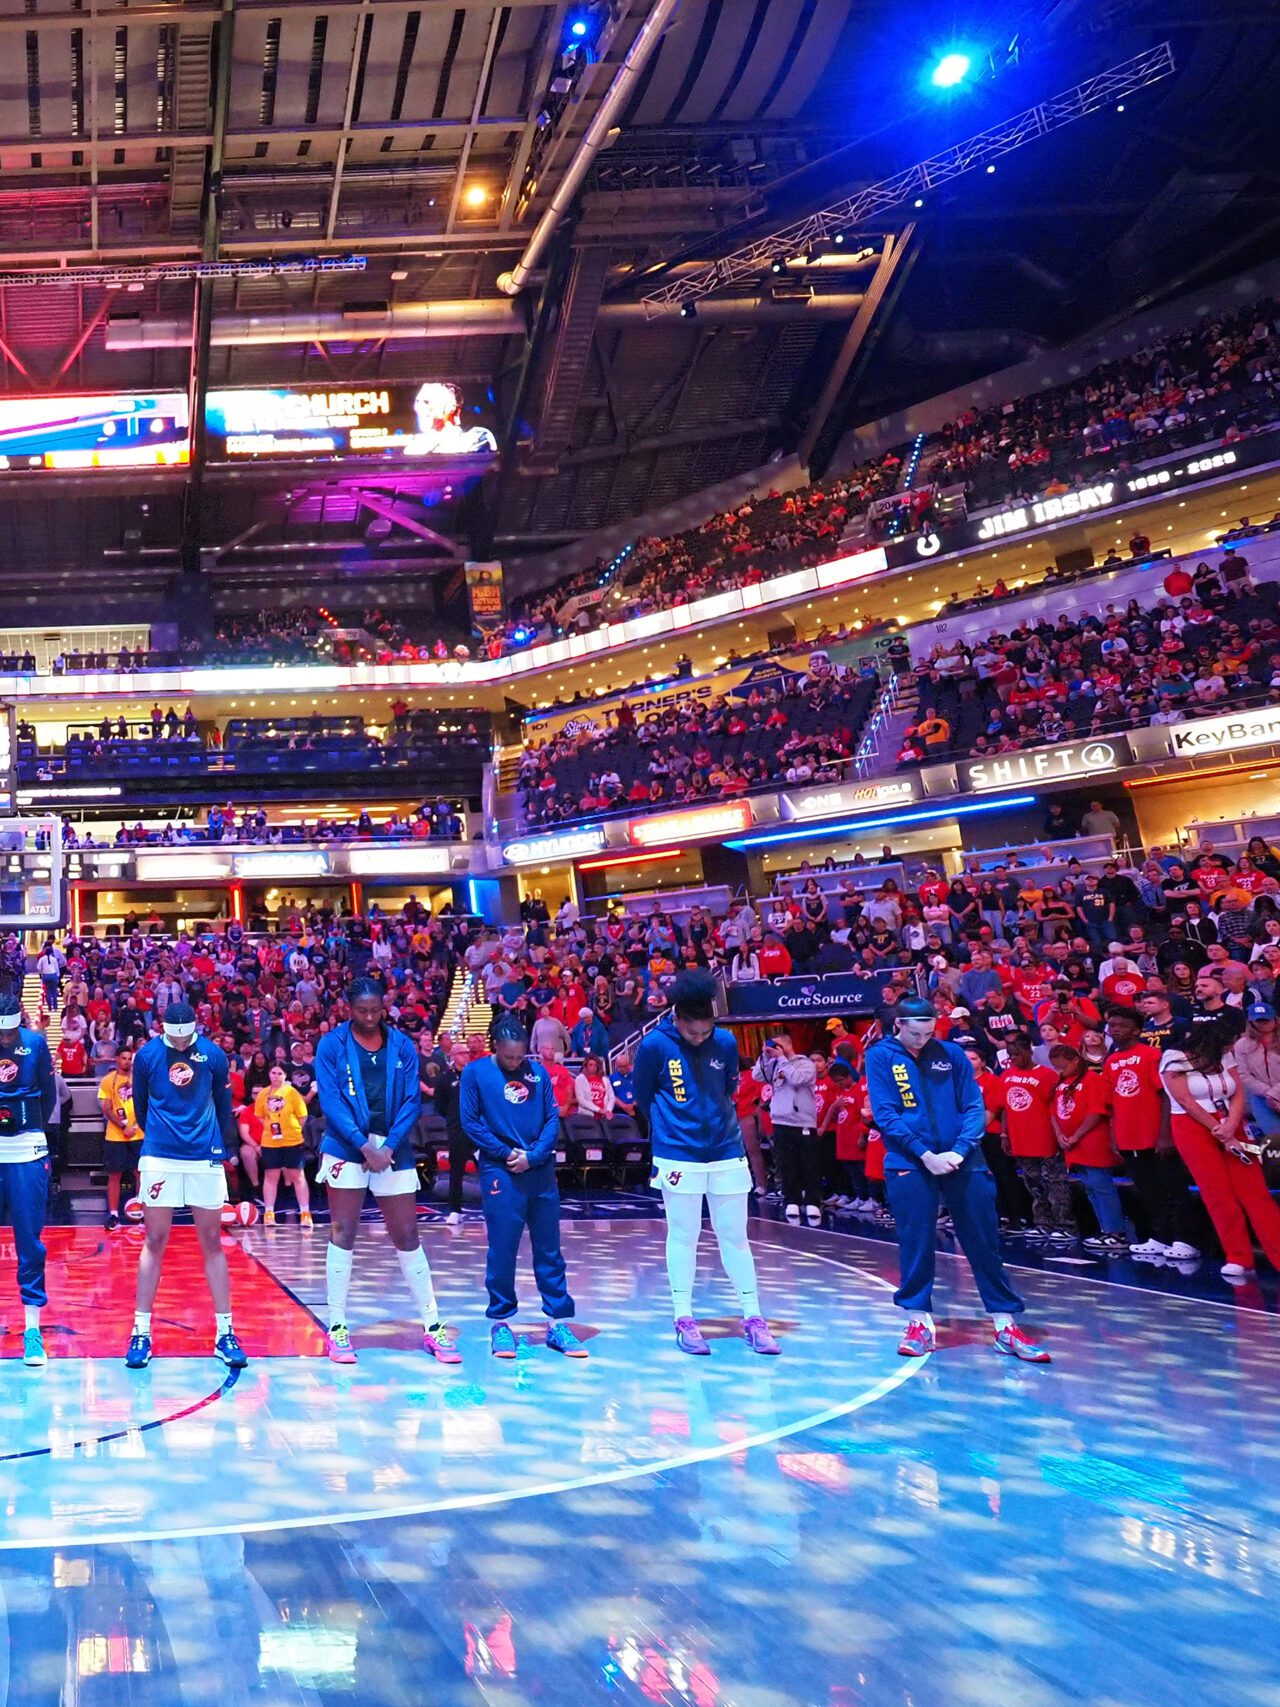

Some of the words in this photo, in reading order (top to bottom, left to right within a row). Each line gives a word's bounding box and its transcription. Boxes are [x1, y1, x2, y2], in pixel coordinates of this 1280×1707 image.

[978, 508, 1028, 539] JIM
[1030, 482, 1115, 524] IRSAY
[1187, 451, 1237, 475] 2025
[602, 686, 713, 719] TRNER'S
[531, 721, 548, 732] 101
[970, 749, 1074, 788] SHIFT
[29, 905, 51, 914] AT&T
[778, 992, 863, 1008] CareSource
[1147, 1037, 1161, 1048] 22
[669, 1059, 686, 1102] FEVER
[892, 1064, 917, 1108] FEVER
